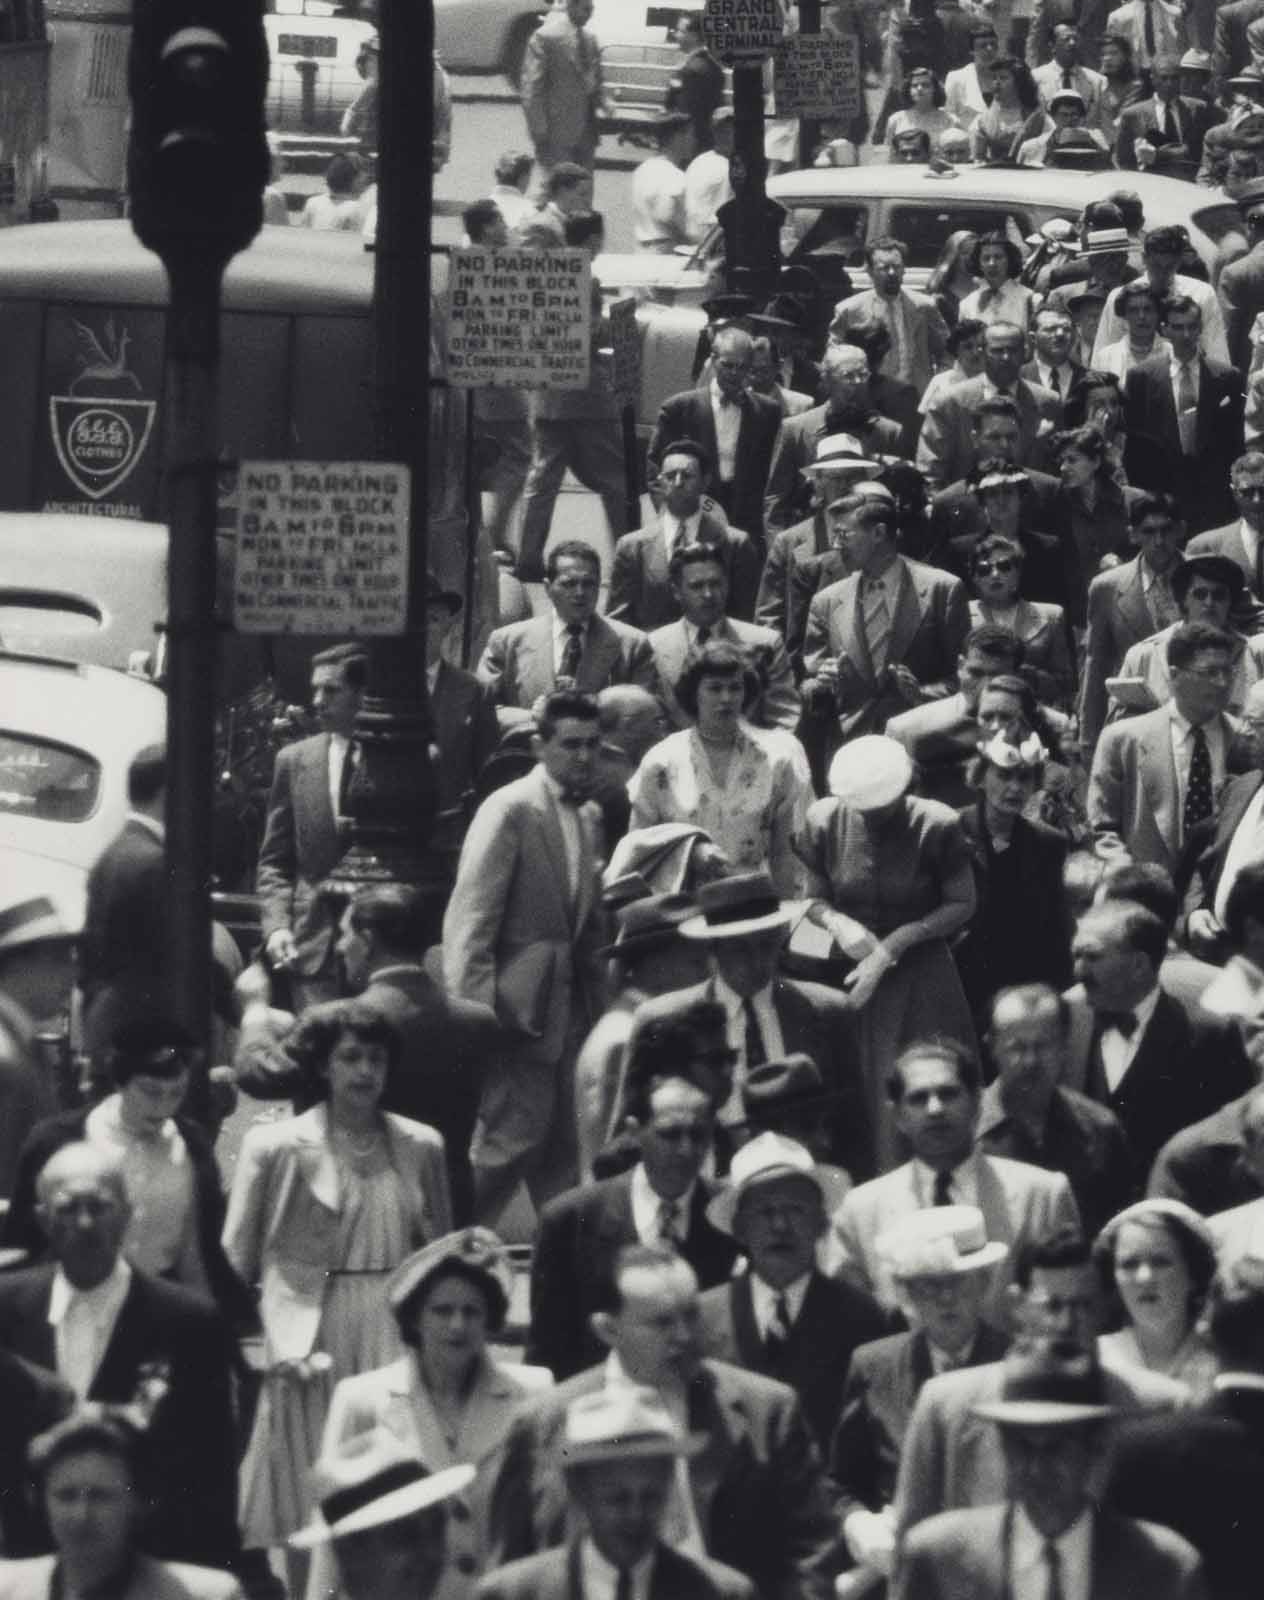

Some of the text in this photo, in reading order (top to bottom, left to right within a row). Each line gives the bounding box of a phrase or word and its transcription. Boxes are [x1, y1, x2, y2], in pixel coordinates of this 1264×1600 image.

[703, 16, 783, 33] CENTRAL
[705, 34, 776, 50] TERMINAL
[456, 255, 583, 273] NO PARKING
[458, 275, 577, 290] IN THIS BLOCK
[465, 323, 570, 337] PARKING LIMIT
[247, 473, 398, 494] NO PARKING
[42, 500, 144, 520] ARCHITECTURAL
[250, 496, 395, 514] IN THIS BLOCK
